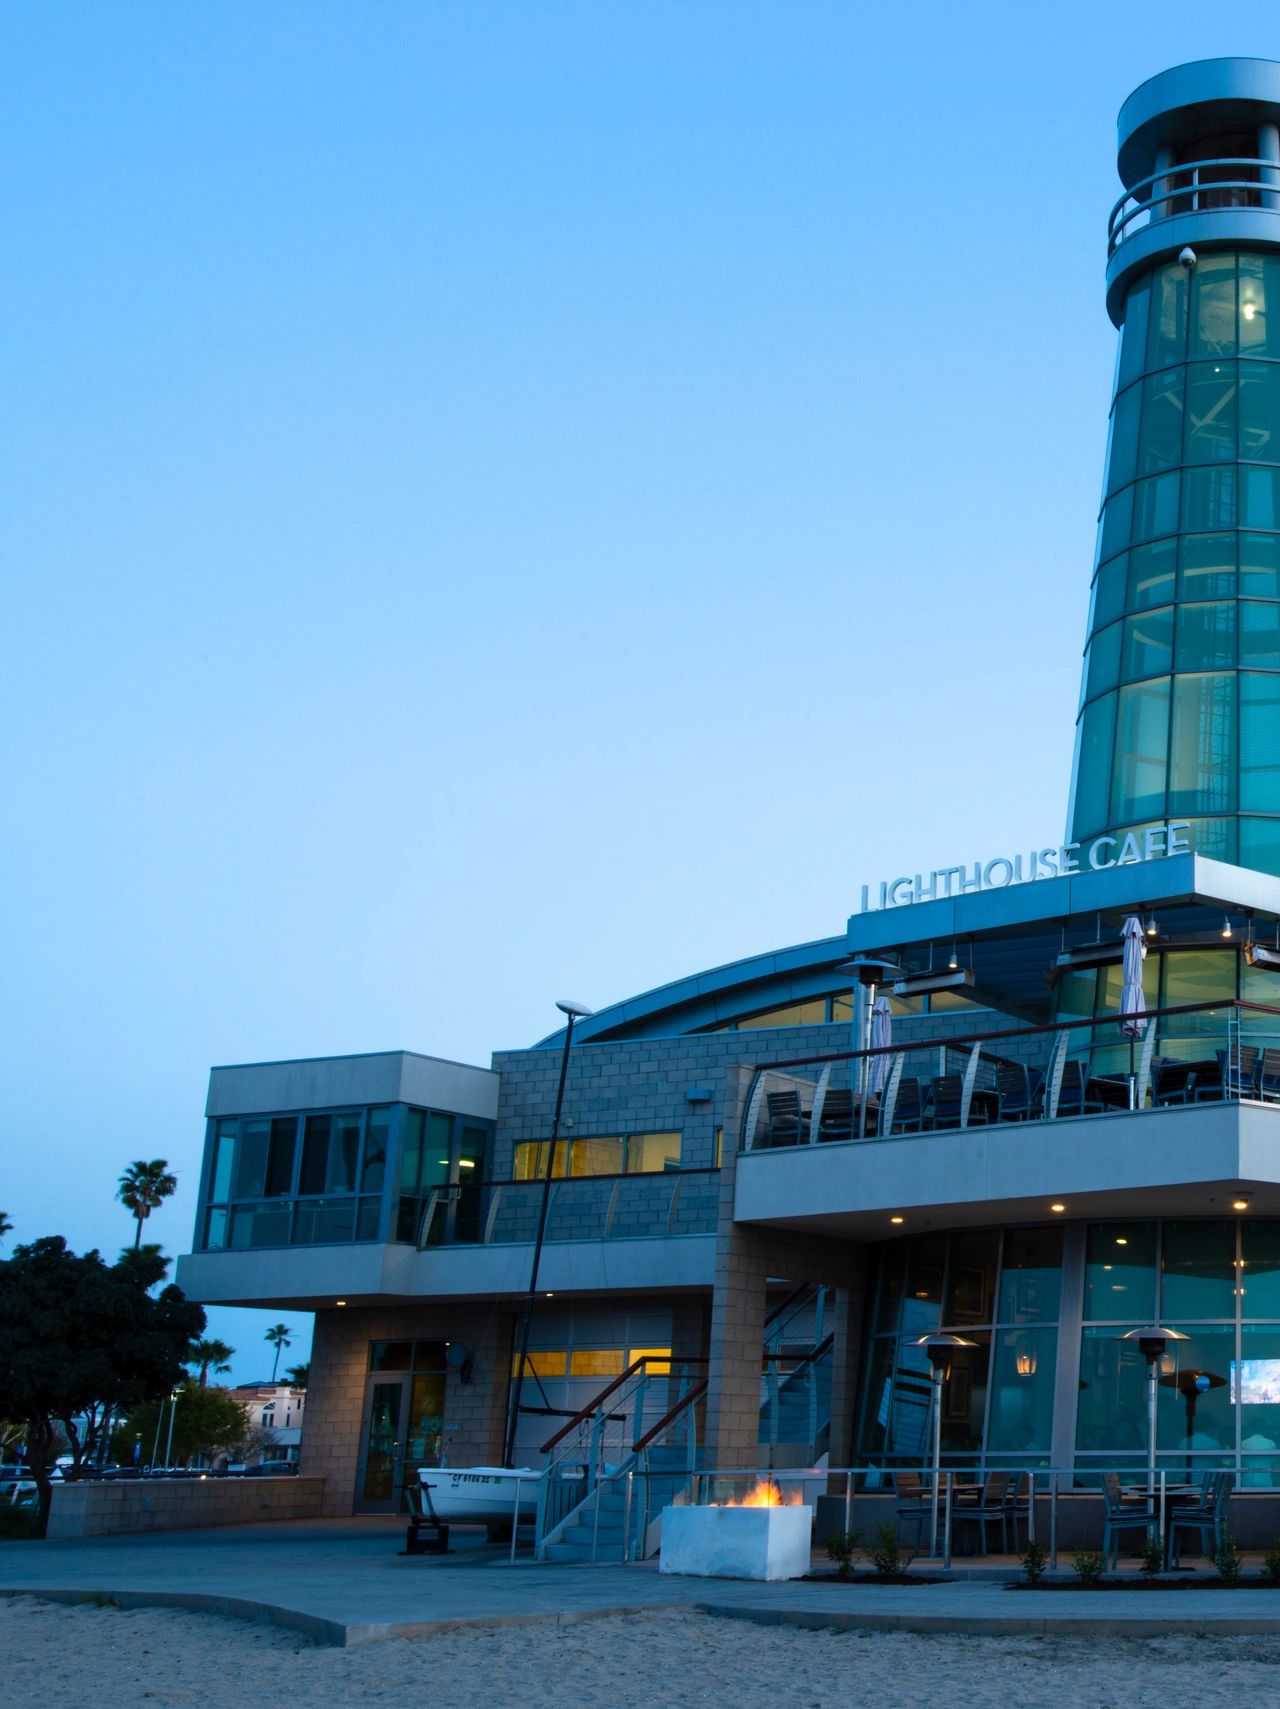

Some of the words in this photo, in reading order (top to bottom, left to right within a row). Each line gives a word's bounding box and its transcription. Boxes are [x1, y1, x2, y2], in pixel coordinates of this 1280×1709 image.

[861, 842, 1081, 913] LIGHTHOUSE
[1088, 822, 1191, 871] CAFE
[453, 1474, 462, 1482] CF
